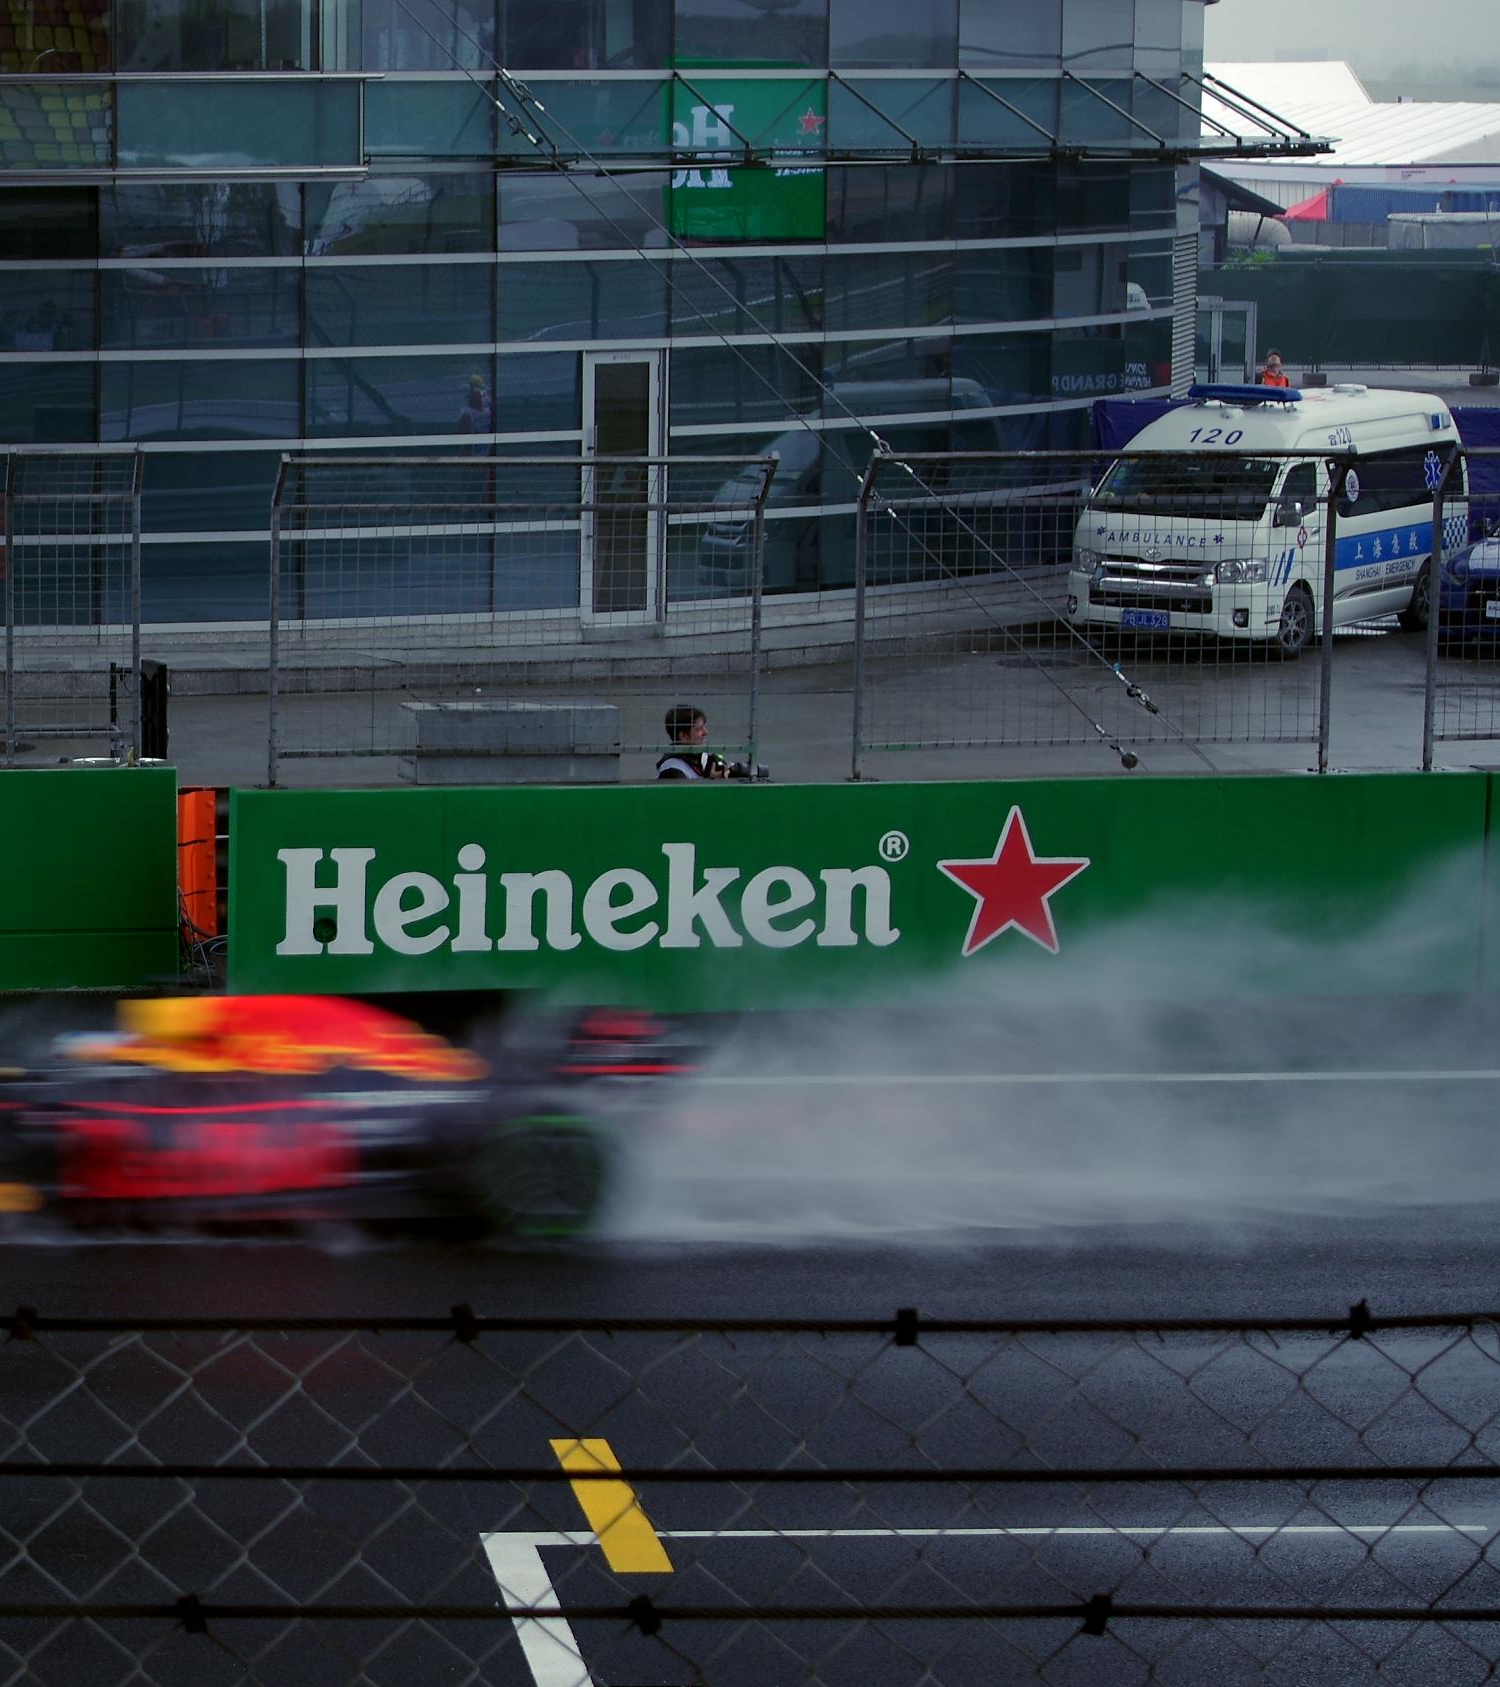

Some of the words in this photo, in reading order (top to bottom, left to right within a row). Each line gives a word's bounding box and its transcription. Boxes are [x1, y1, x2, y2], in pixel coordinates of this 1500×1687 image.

[1189, 427, 1244, 446] 120
[1337, 427, 1353, 445] 120
[1107, 531, 1207, 548] AMBULANCE
[1354, 530, 1419, 560] 上海急救
[276, 842, 900, 956] Heineken
